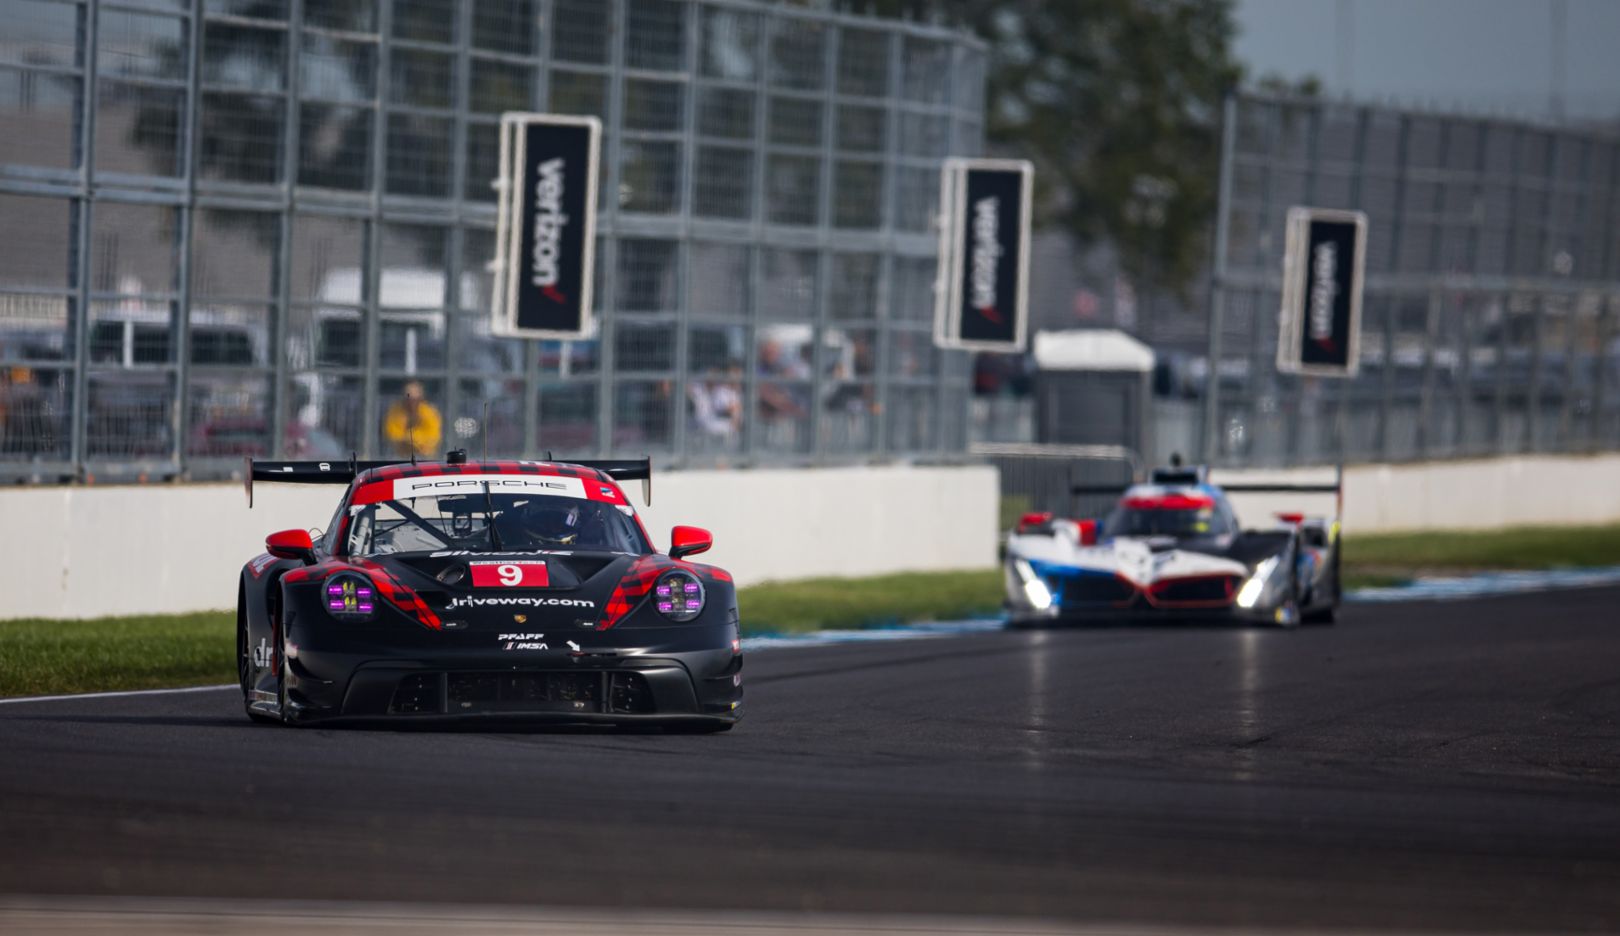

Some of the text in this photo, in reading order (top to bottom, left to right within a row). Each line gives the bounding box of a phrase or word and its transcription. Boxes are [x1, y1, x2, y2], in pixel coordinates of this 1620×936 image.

[532, 157, 568, 287] verizon
[411, 480, 567, 491] PORSCHE
[497, 564, 523, 586] 9
